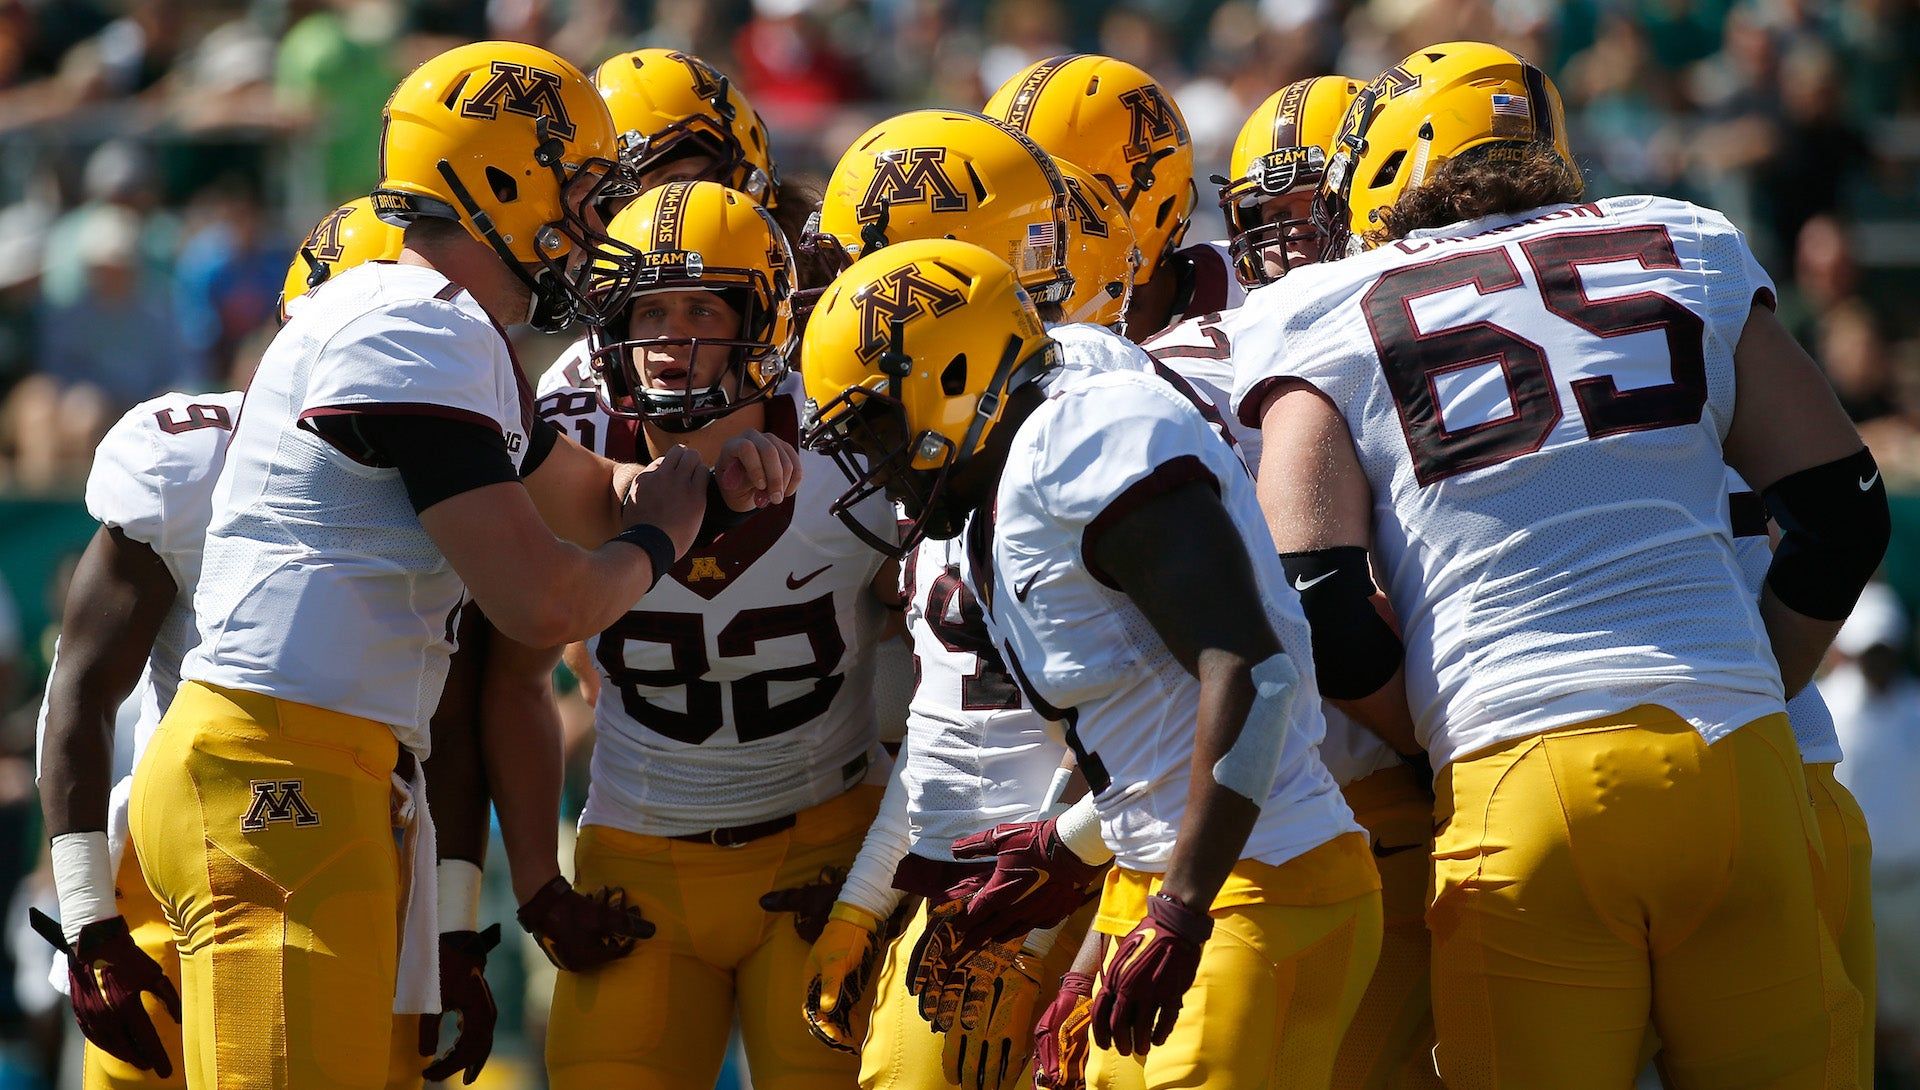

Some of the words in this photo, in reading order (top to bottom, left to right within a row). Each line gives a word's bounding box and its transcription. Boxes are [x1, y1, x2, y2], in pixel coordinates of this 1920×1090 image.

[461, 61, 577, 142] M
[1118, 84, 1188, 163] M
[856, 147, 968, 224] M
[1268, 150, 1307, 167] TEAM
[377, 194, 411, 210] BRICK
[643, 252, 685, 266] TEAM
[850, 262, 968, 365] M
[1360, 224, 1708, 488] 65
[687, 556, 726, 582] M
[596, 591, 847, 745] 82
[240, 779, 322, 832] M
